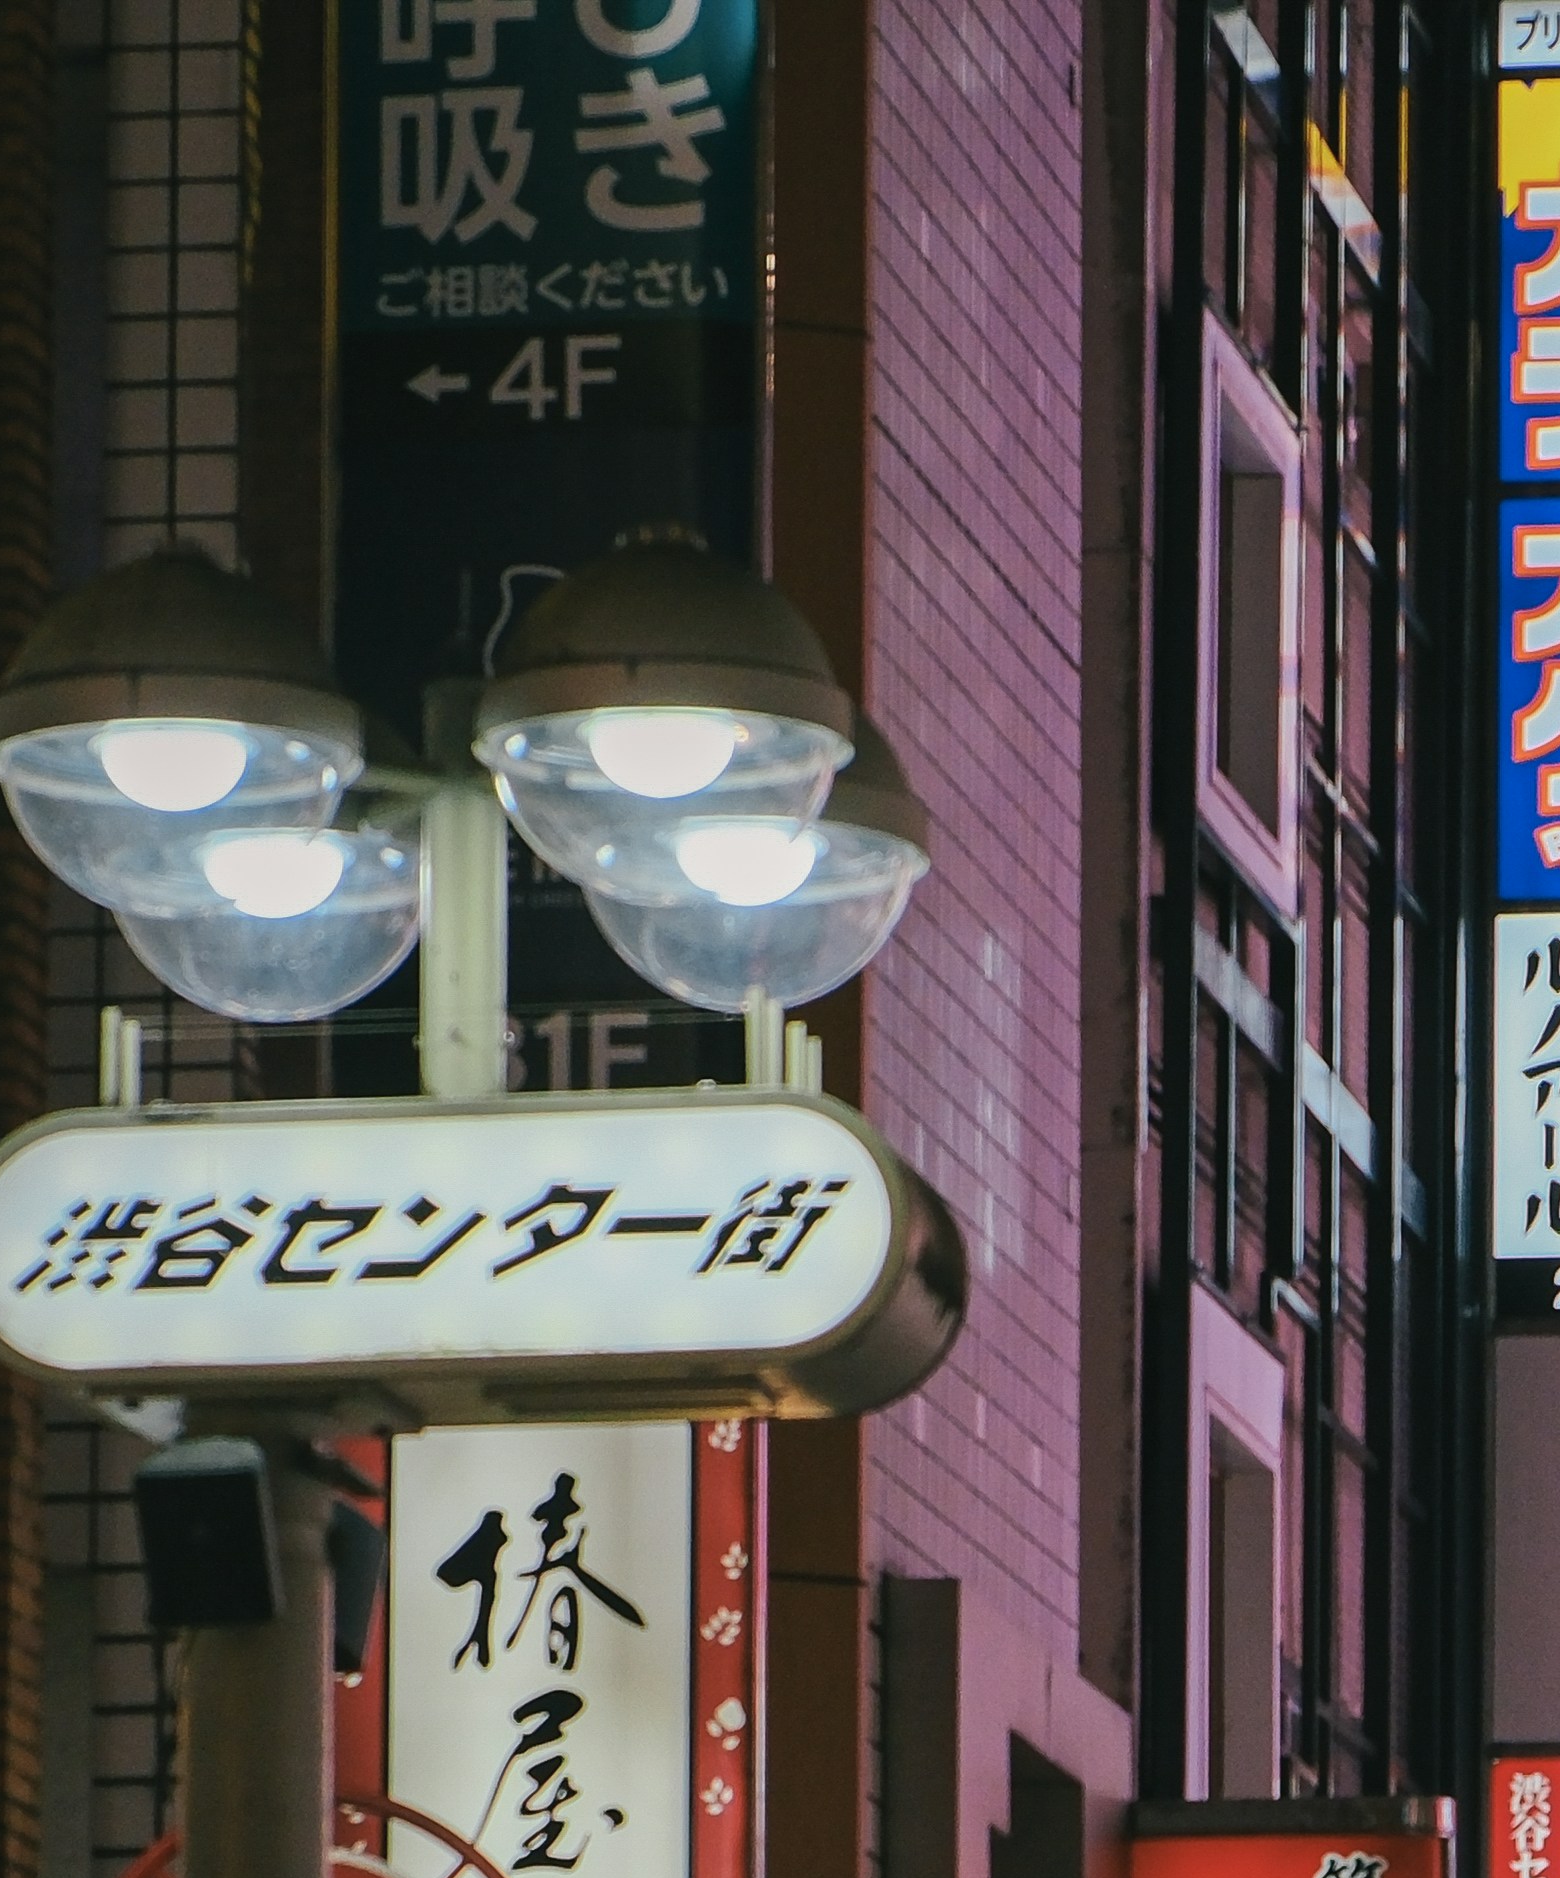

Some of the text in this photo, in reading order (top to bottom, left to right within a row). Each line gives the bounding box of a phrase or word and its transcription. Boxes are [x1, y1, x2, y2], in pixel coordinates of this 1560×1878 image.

[376, 260, 729, 319] ご相談ください
[487, 333, 624, 422] 4F
[15, 1178, 856, 1295] 渋谷センター街
